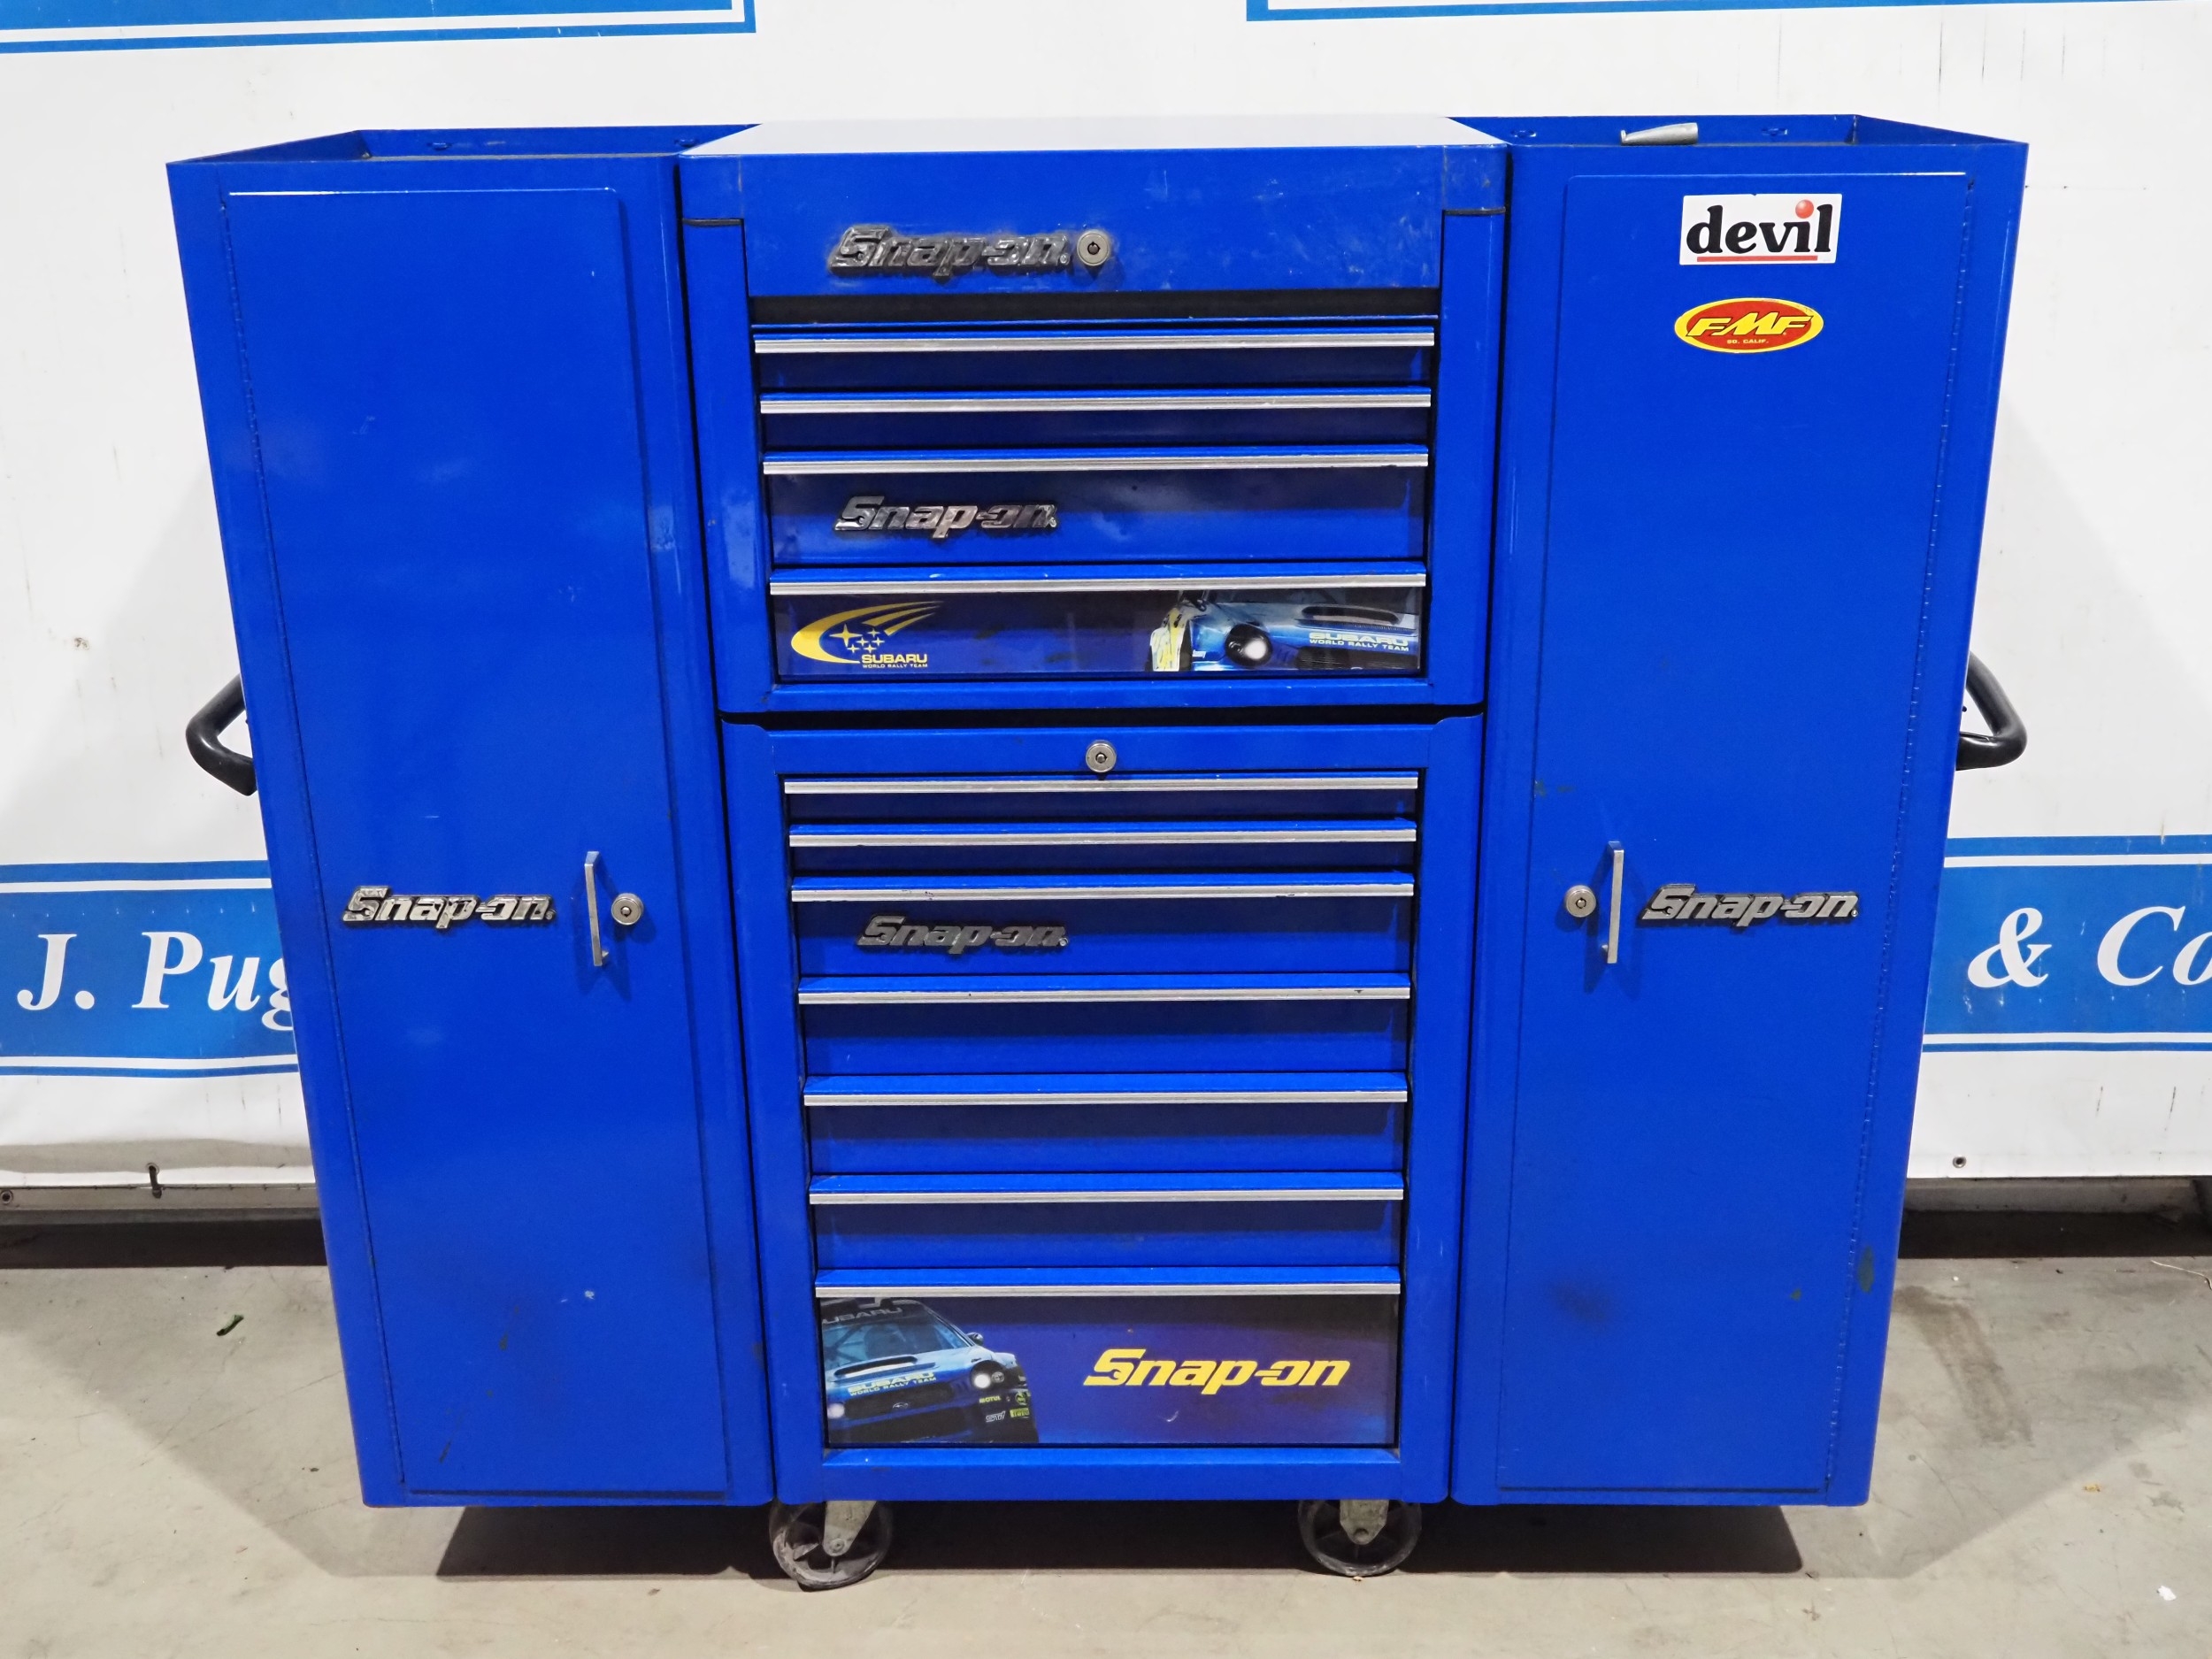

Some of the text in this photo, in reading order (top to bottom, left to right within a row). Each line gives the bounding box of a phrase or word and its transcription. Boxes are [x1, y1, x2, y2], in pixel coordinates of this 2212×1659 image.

[1686, 200, 1833, 254] devil
[1686, 311, 1814, 337] FMF
[835, 495, 1056, 539] Snap-on
[861, 654, 927, 664] SUBARU
[1310, 632, 1409, 647] SUBARU
[342, 886, 556, 929] Snap-on
[1641, 884, 1859, 927] Snap-on
[856, 915, 1068, 955] Snap-on
[17, 933, 95, 1010] J.
[1968, 907, 2053, 988] &
[1083, 1348, 1350, 1395] Snap-on
